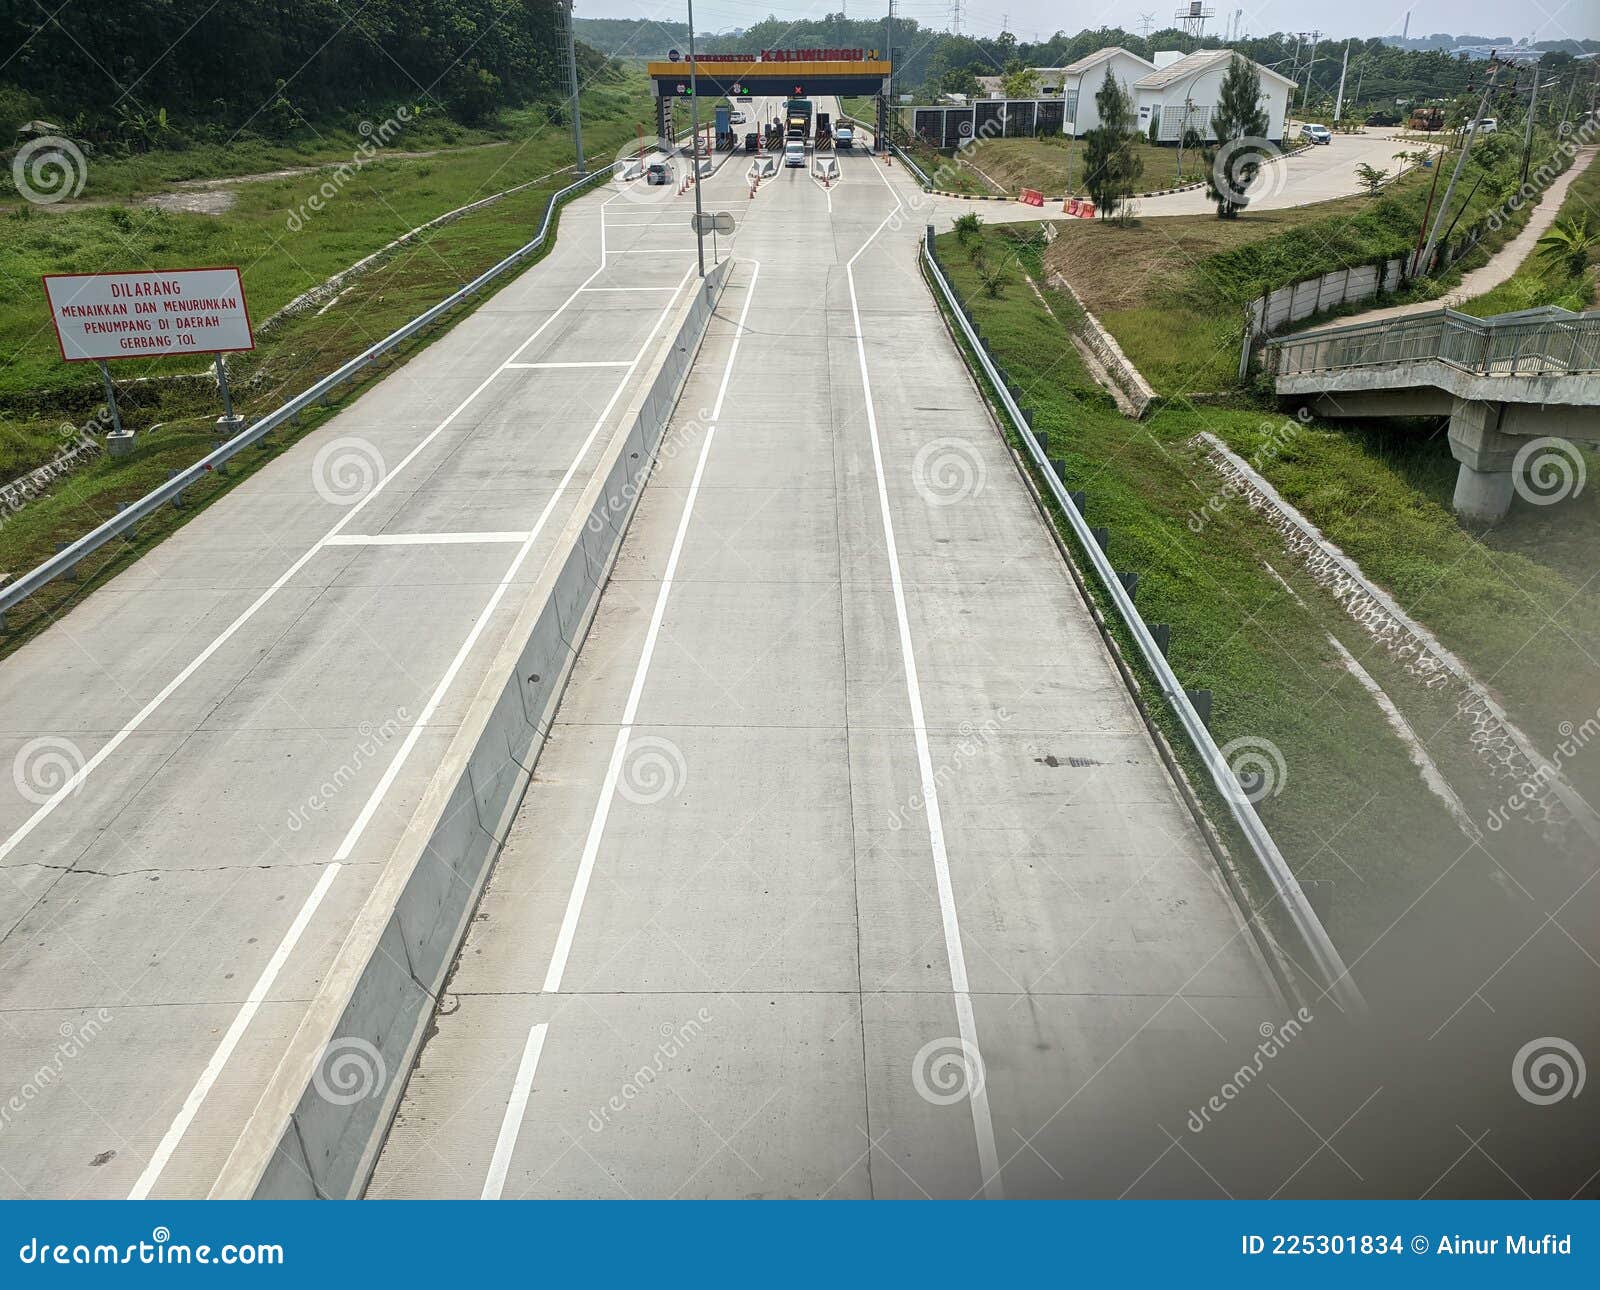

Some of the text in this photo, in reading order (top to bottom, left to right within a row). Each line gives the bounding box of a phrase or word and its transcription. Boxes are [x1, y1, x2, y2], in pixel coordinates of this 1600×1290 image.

[761, 48, 863, 61] KALIWUNGU
[111, 281, 181, 297] DILARANG
[61, 298, 236, 317] MENAIKKAN DAN MENURUNKAN
[84, 316, 219, 334] PENUMPANG DI DAERAH
[120, 334, 196, 348] GERBANG TOL
